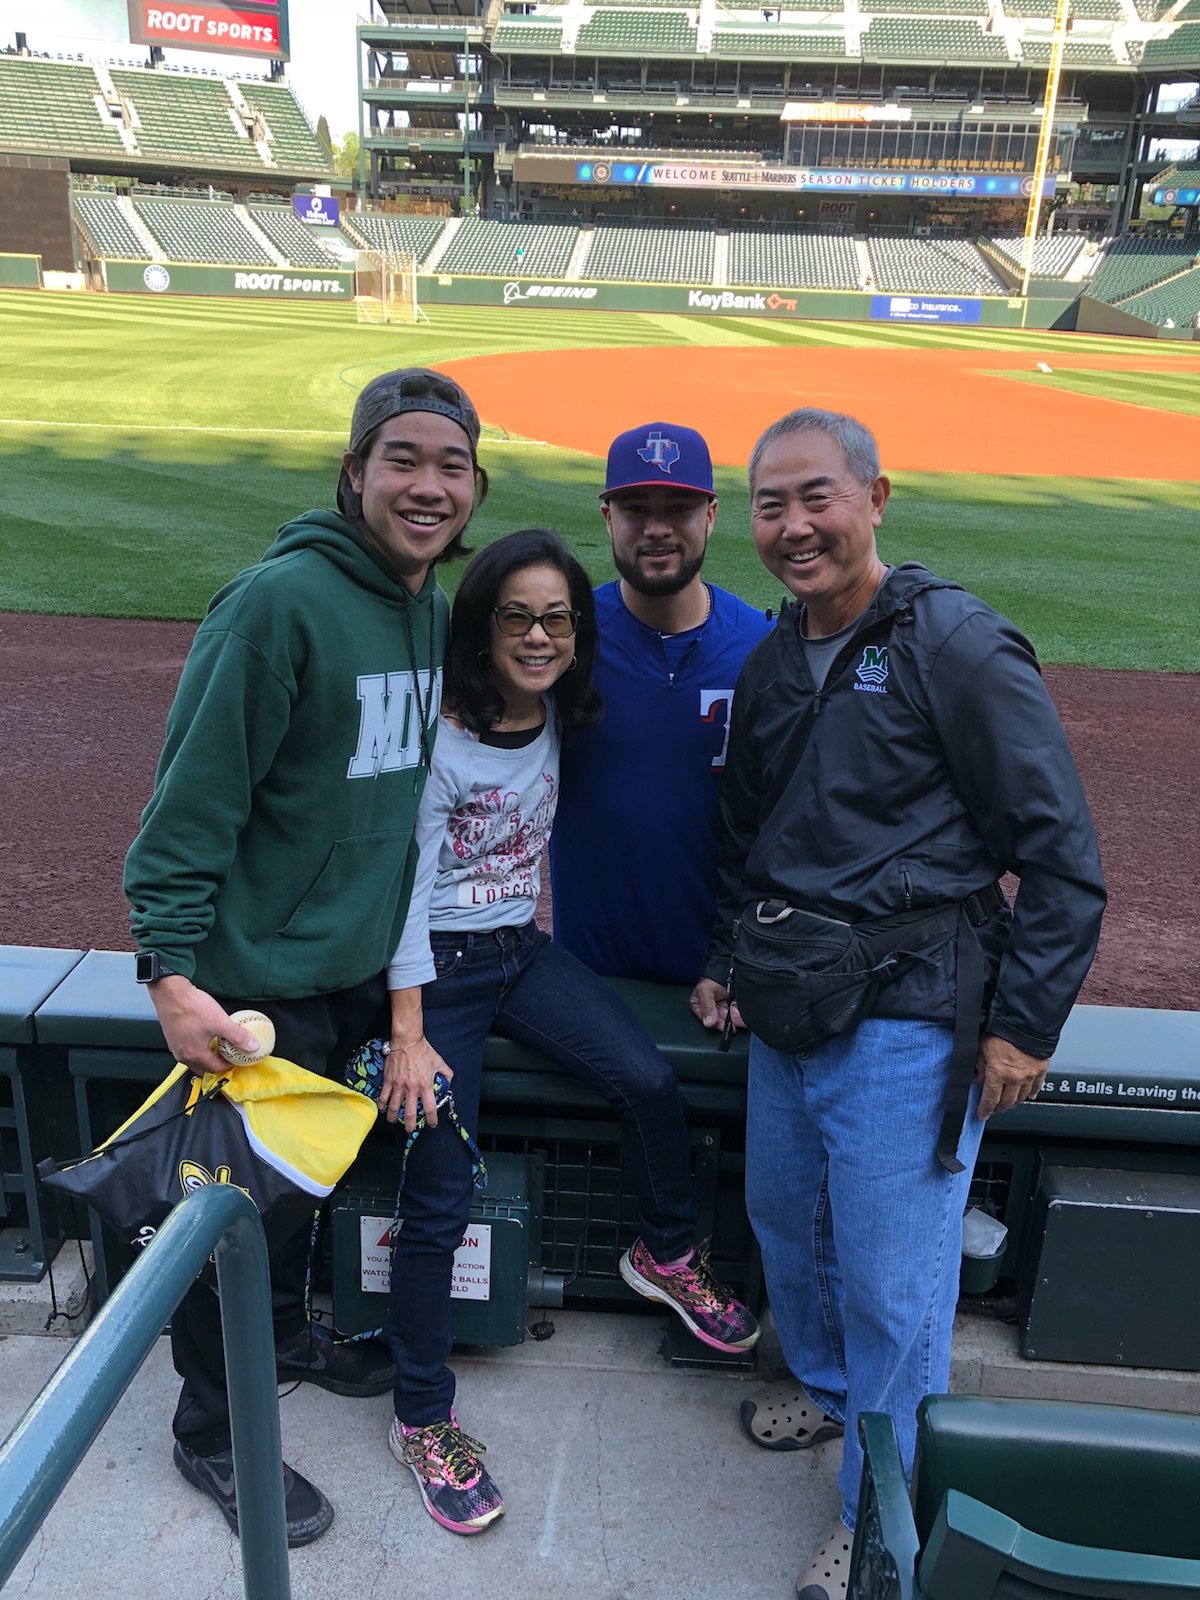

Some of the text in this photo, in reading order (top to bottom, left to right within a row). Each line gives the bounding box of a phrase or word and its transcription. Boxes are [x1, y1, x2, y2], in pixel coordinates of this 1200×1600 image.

[147, 9, 273, 43] ROOT SPORTS
[653, 168, 717, 181] WELCOME
[761, 171, 797, 183] MARINERS
[801, 173, 852, 184] SEASON
[859, 175, 904, 186] TICKET
[911, 177, 974, 188] HOLDERS
[821, 202, 856, 213] ROOT
[234, 272, 341, 293] ROOT SPORTS
[525, 285, 598, 299] BOEING
[688, 290, 766, 311] KeyBank
[853, 683, 888, 694] BASEBALL
[1059, 1080, 1070, 1092] &
[1075, 1081, 1113, 1095] Balls
[1117, 1083, 1177, 1101] Leaving
[366, 1255, 383, 1263] YOU
[456, 1262, 485, 1270] ACTION
[459, 1275, 489, 1285] BALLS
[450, 1285, 469, 1293] ELD
